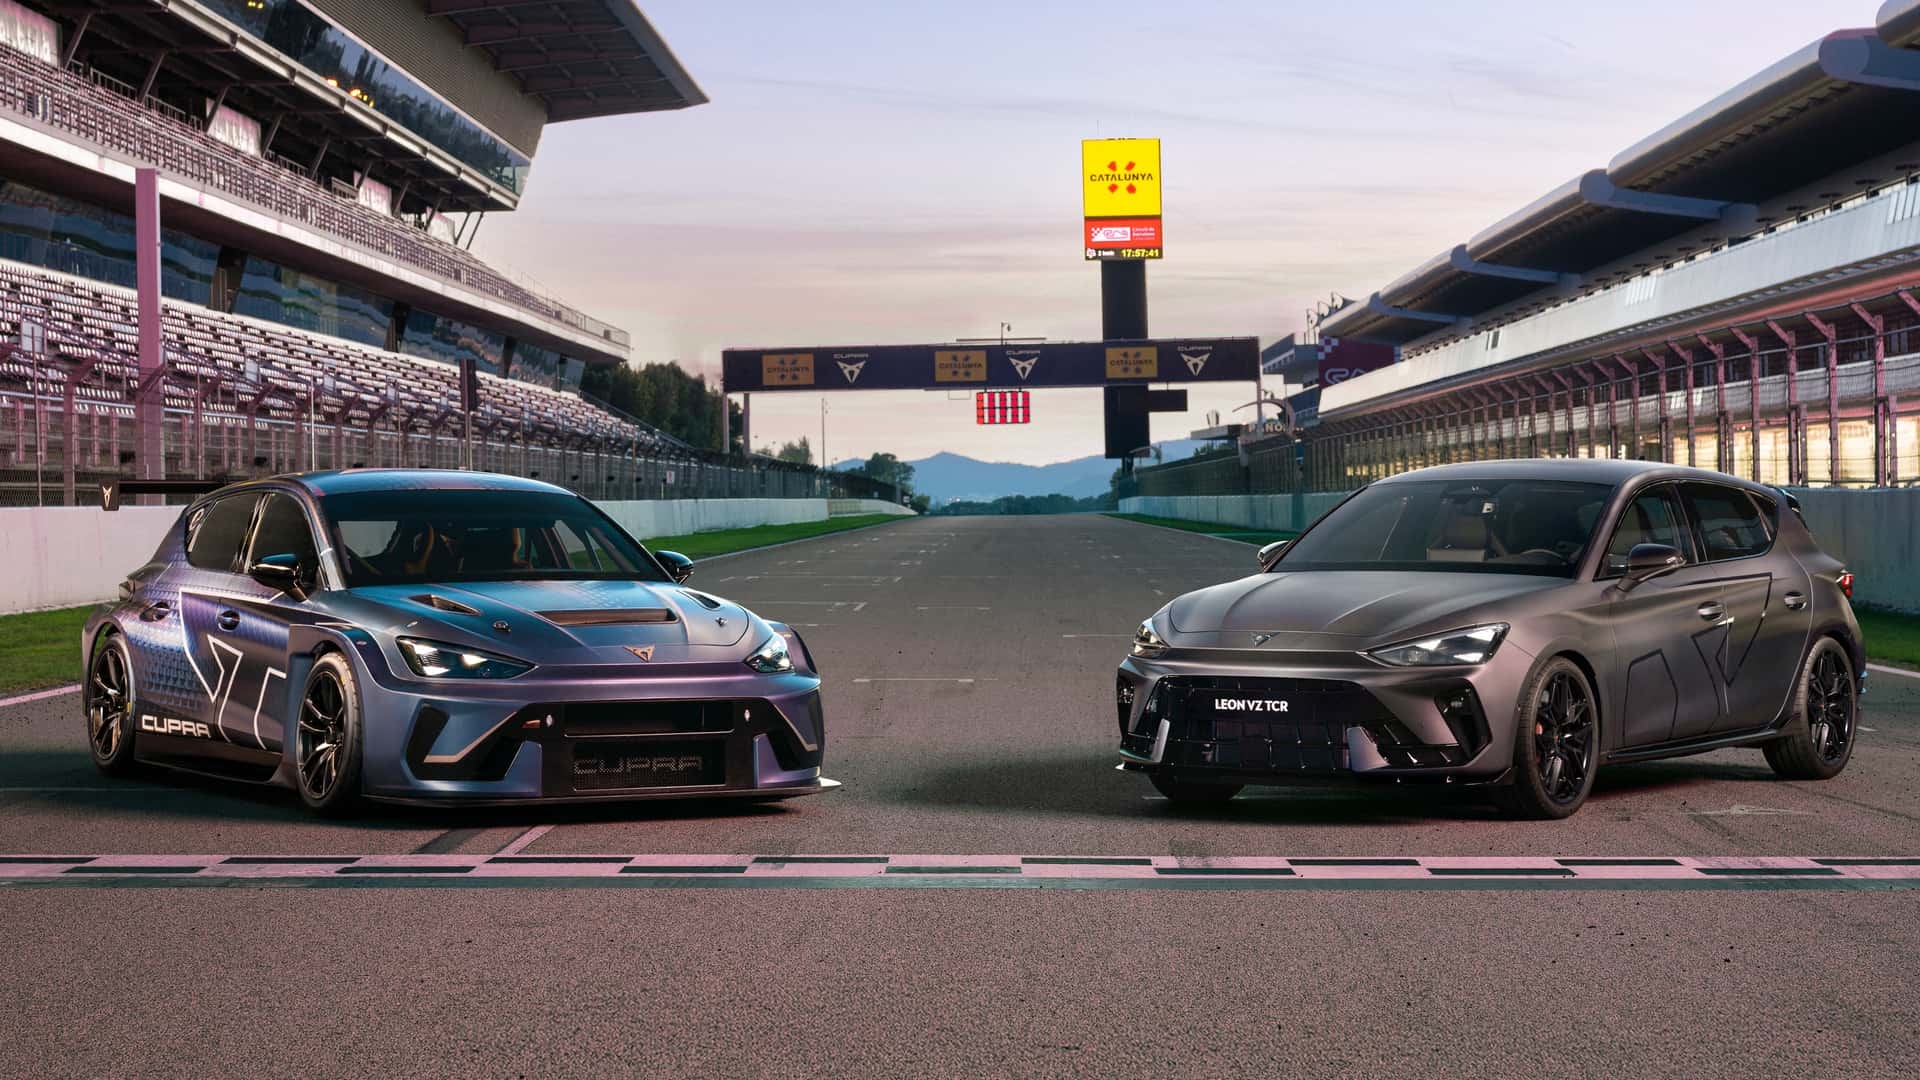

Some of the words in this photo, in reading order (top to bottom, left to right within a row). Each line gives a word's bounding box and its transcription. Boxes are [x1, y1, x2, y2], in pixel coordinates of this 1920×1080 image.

[1089, 173, 1153, 182] CATALUNYA
[1121, 248, 1159, 257] 17:57:41
[1215, 698, 1246, 711] LEON
[1247, 699, 1264, 712] VZ
[1264, 700, 1289, 712] TCR
[142, 714, 212, 739] CUPRA
[575, 756, 703, 775] CUPRA
